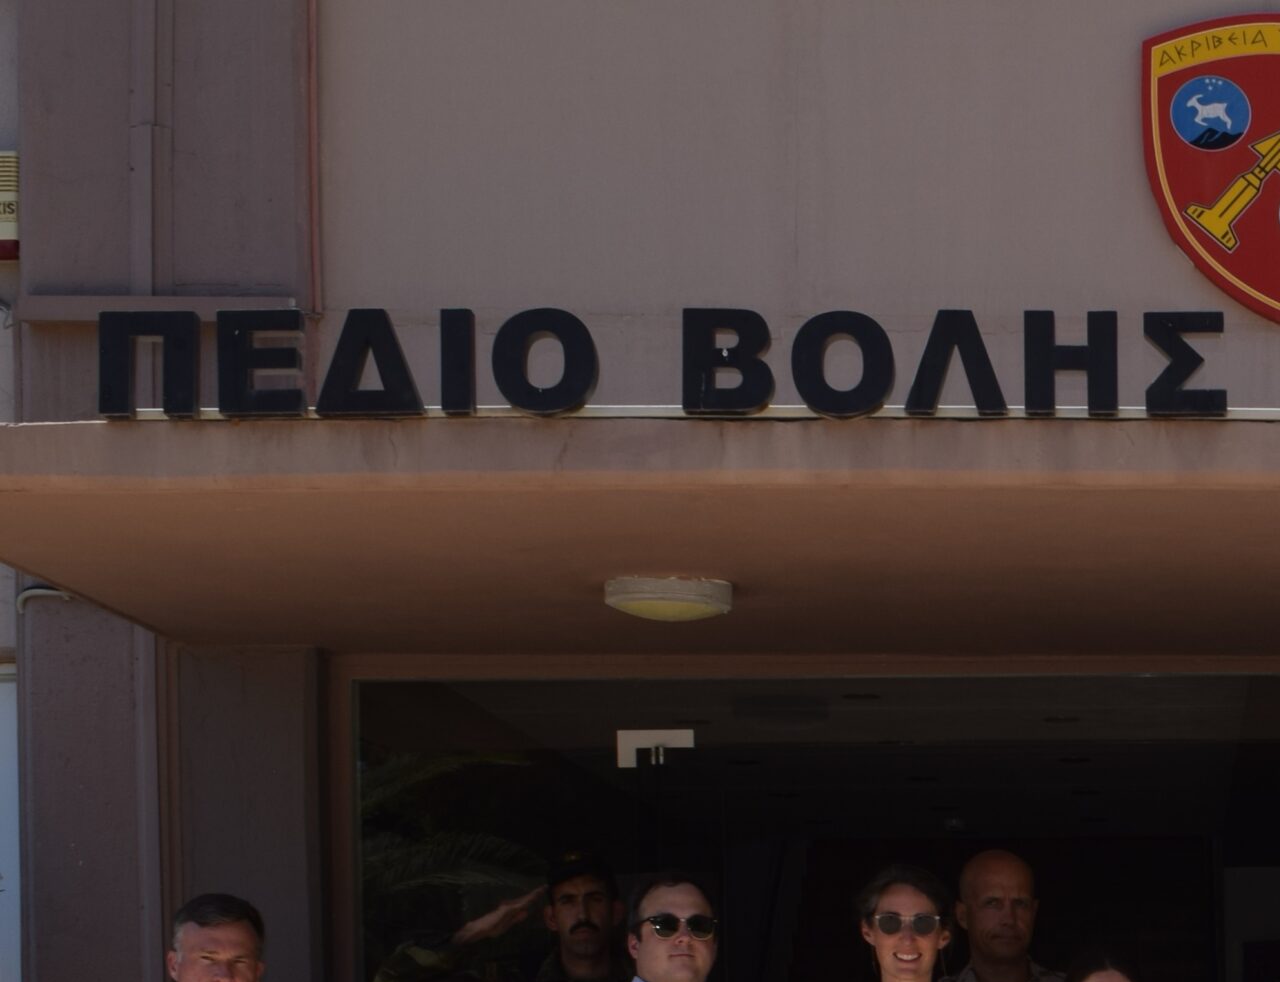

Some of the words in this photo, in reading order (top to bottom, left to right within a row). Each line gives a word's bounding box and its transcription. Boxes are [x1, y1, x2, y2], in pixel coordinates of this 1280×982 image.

[1158, 29, 1268, 68] ΑΚΡΙΒΕΙΑ
[98, 308, 598, 418] ΠΕΔΙΟ
[682, 308, 1228, 418] ΒΟΛΗΣ
